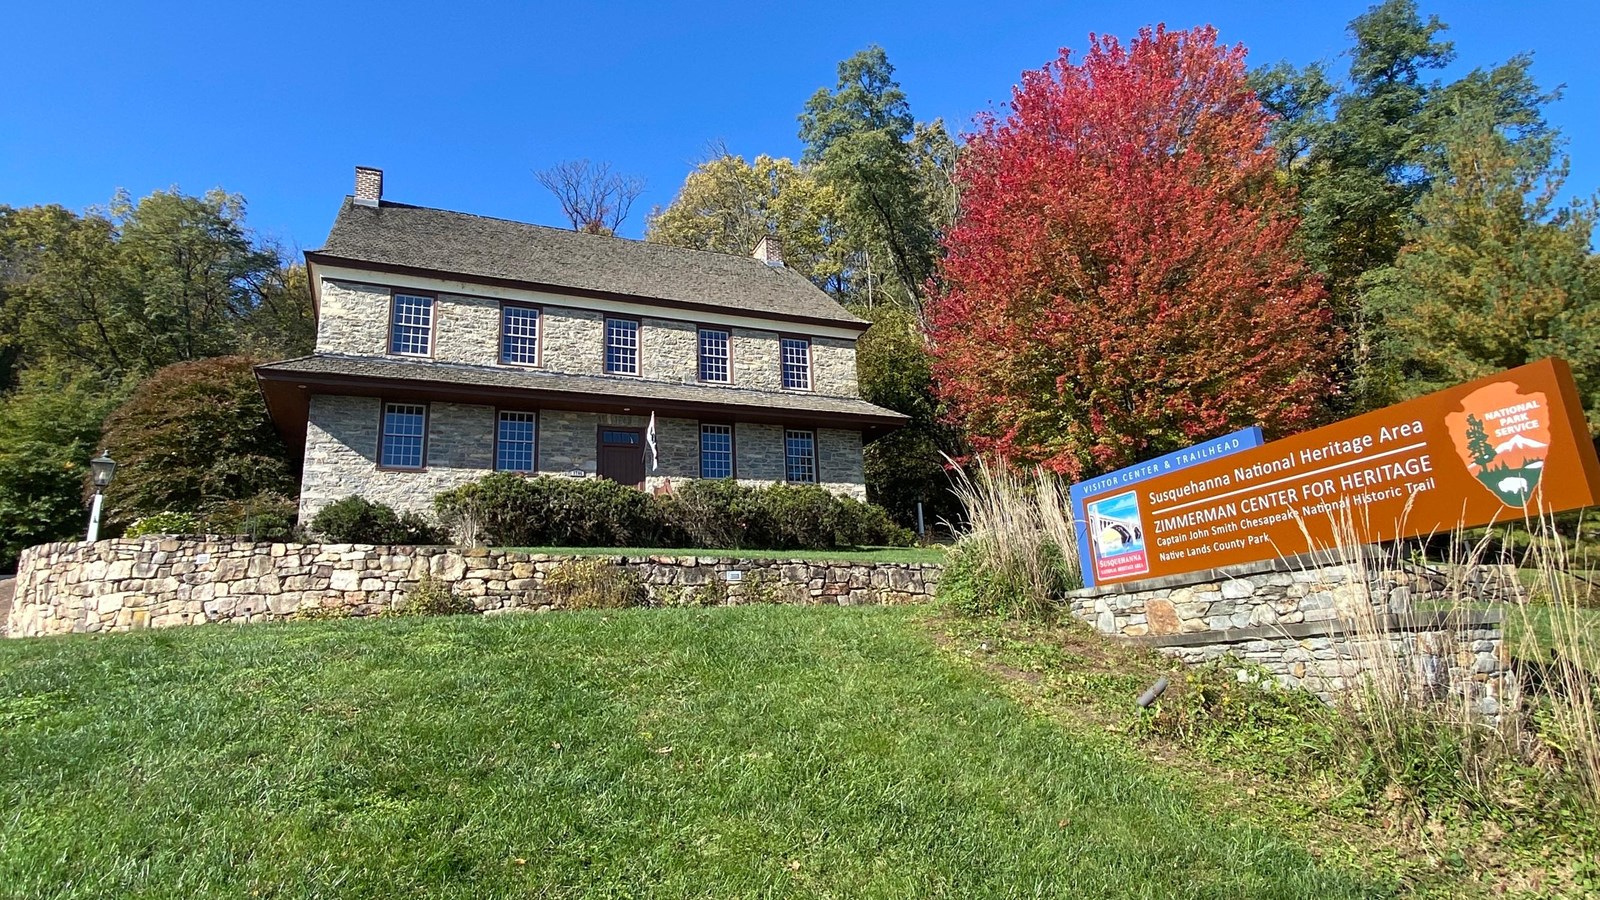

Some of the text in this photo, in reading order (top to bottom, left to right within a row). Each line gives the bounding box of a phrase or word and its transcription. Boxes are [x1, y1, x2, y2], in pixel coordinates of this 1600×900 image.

[1485, 400, 1540, 420] NATIONAL
[1500, 412, 1529, 426] PARK
[1495, 420, 1540, 437] SERVICE
[1083, 438, 1240, 494] VISITOR CENTER & TRAILHEAD
[1149, 420, 1424, 505] Susquehanna National Heritage Area
[1154, 454, 1433, 534] ZIMMERMAN CENTER FOR HERITAGE
[1156, 477, 1436, 547] Captain John Smith Chesapeake National Historic Trail
[1100, 554, 1142, 568] SUSQUEHANNA
[1159, 532, 1270, 562] Native Lands County Park
